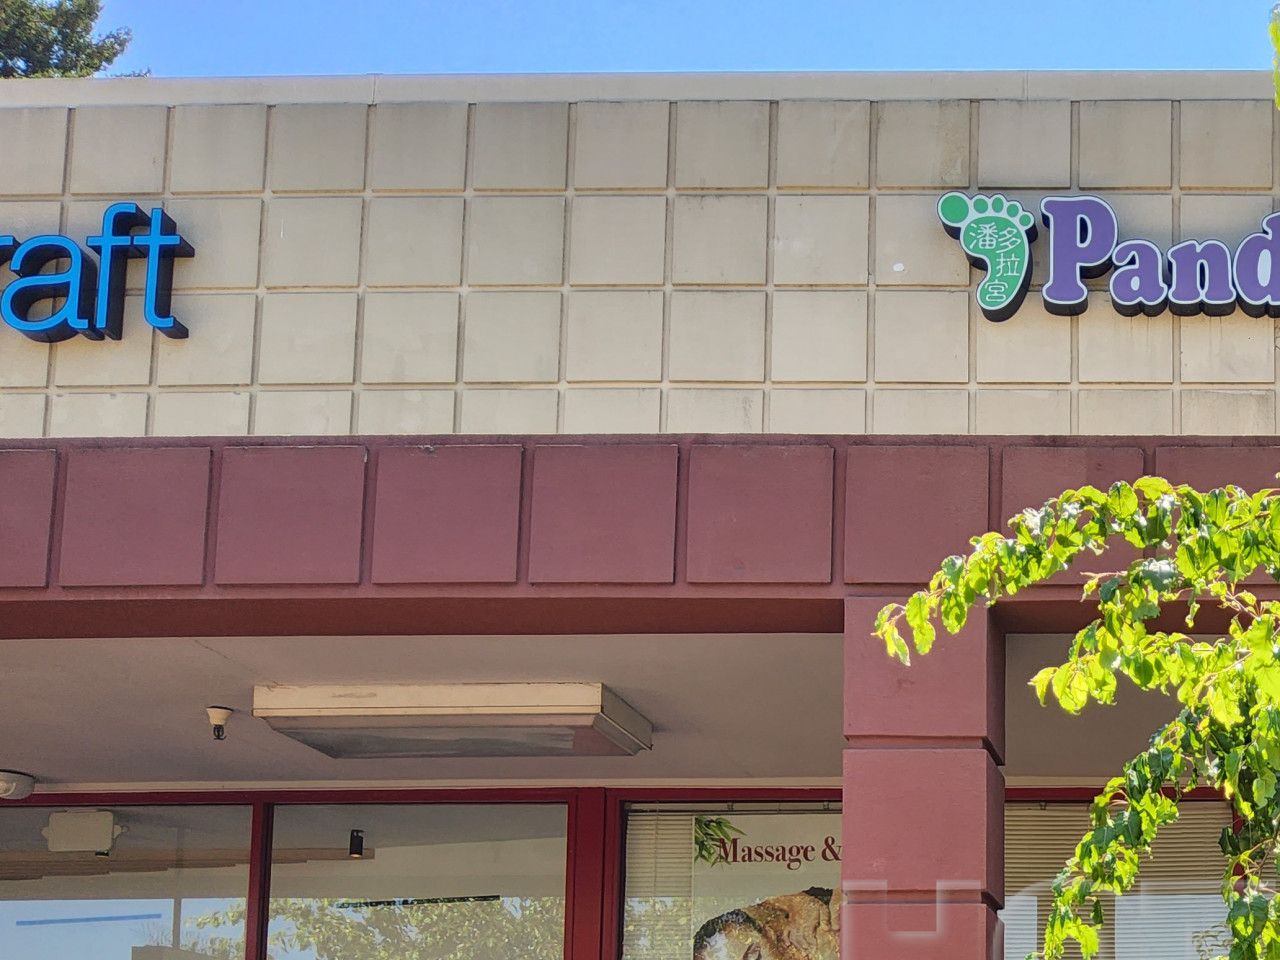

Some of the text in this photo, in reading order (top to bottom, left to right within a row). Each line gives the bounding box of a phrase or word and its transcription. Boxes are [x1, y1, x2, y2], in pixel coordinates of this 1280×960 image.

[0, 203, 184, 333] aft
[718, 836, 842, 870] Massage &
